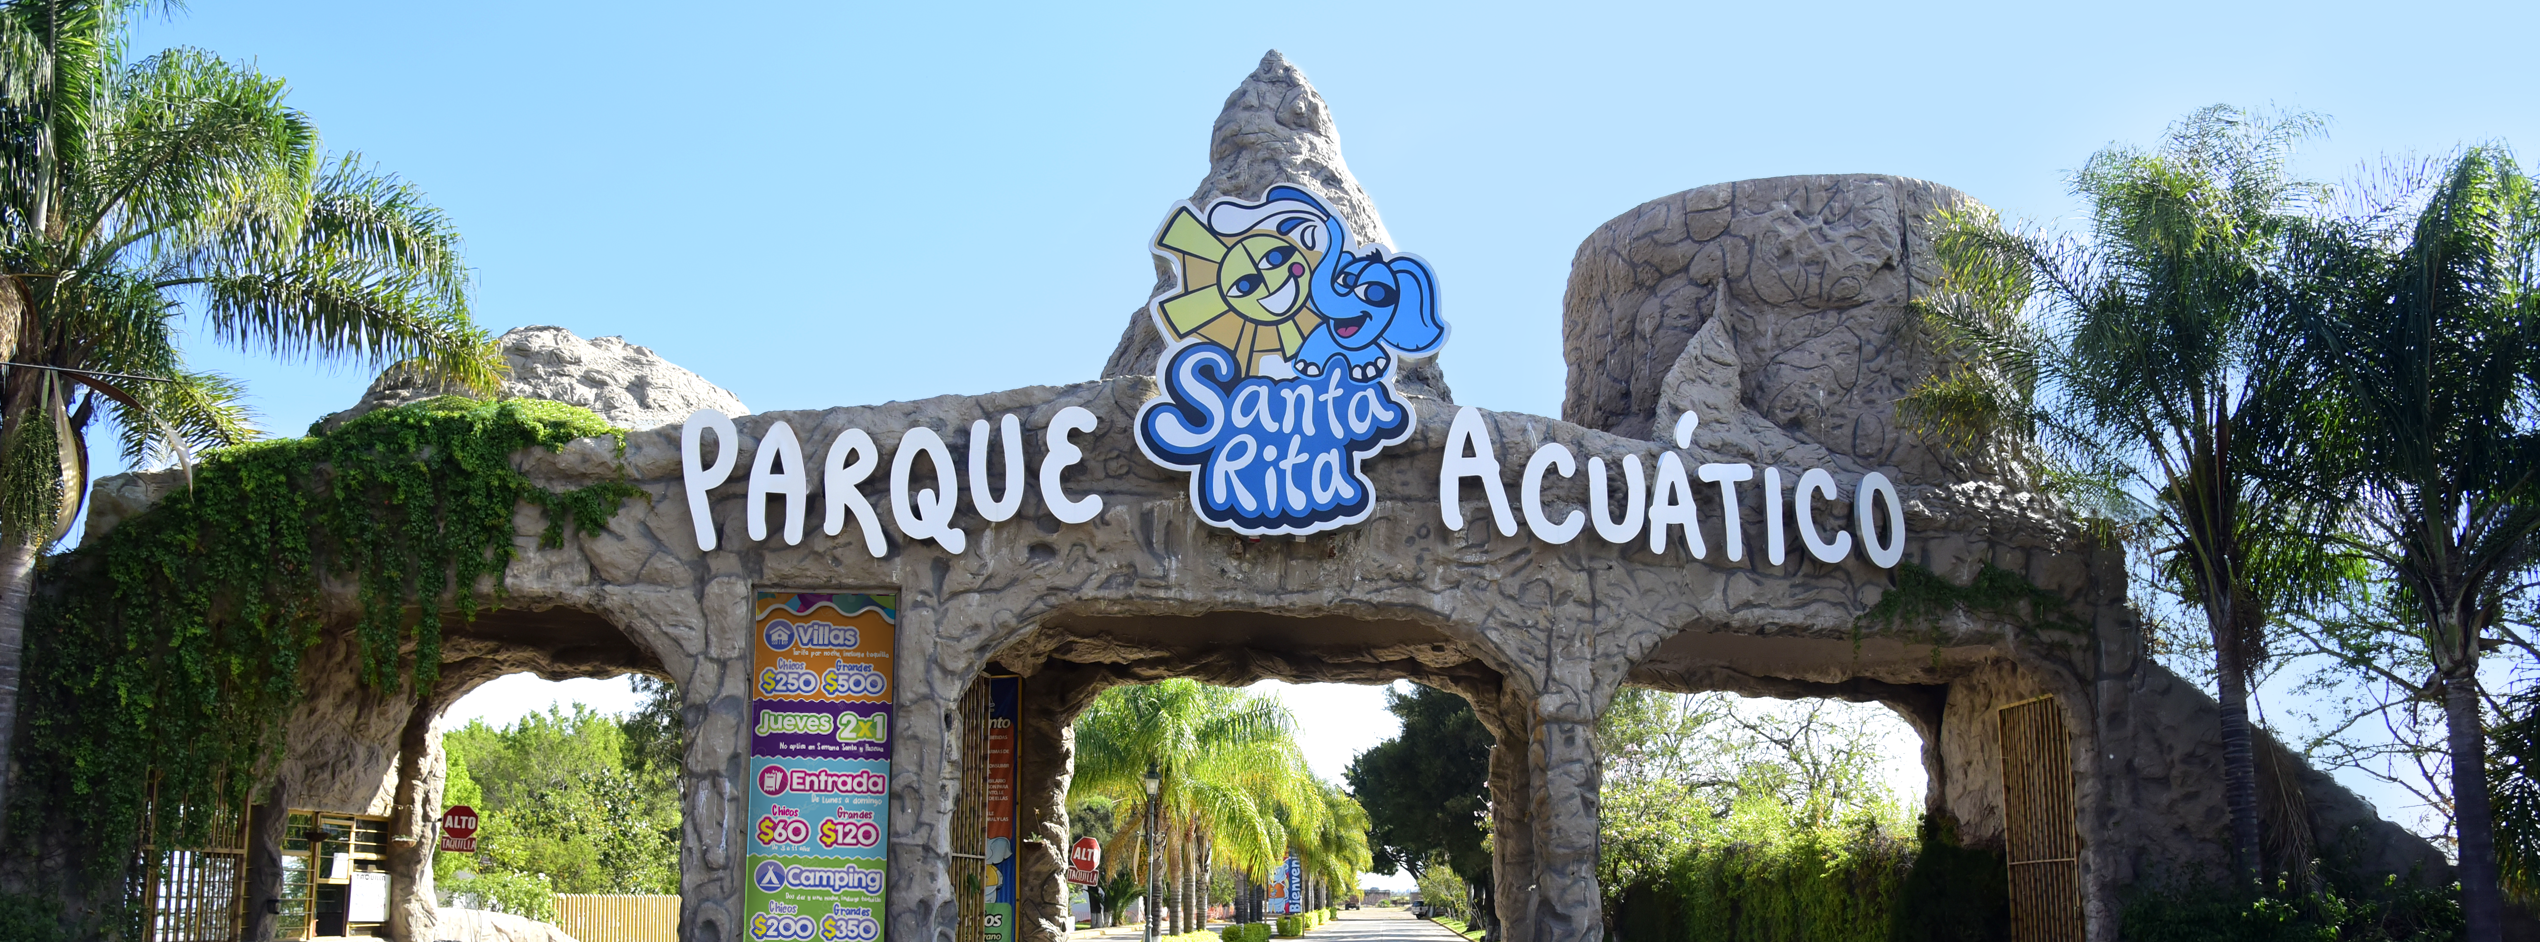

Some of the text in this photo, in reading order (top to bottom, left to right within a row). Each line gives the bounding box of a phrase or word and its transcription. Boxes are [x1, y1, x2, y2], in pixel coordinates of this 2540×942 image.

[1155, 350, 1395, 448] Santa
[1212, 434, 1355, 511] Rita
[681, 406, 1905, 569] PARQUE ACUÁTICO
[797, 624, 857, 646] Villas
[777, 657, 873, 673] Chicos Grandes
[762, 670, 884, 694] $250 $500
[759, 713, 884, 739] Jueves 2x1
[791, 772, 886, 793] Entrada
[771, 804, 873, 820] Chicos Grandes
[852, 796, 883, 807] domingo
[444, 815, 476, 831] ALTO
[758, 819, 878, 845] $60 $120
[442, 837, 477, 850] TAQUILLA
[1073, 846, 1099, 863] ALTO
[787, 867, 881, 891] Camping
[1068, 870, 1098, 885] TAQUILLA
[768, 900, 872, 917] Chicos Grandes
[753, 915, 876, 940] $200 $350
